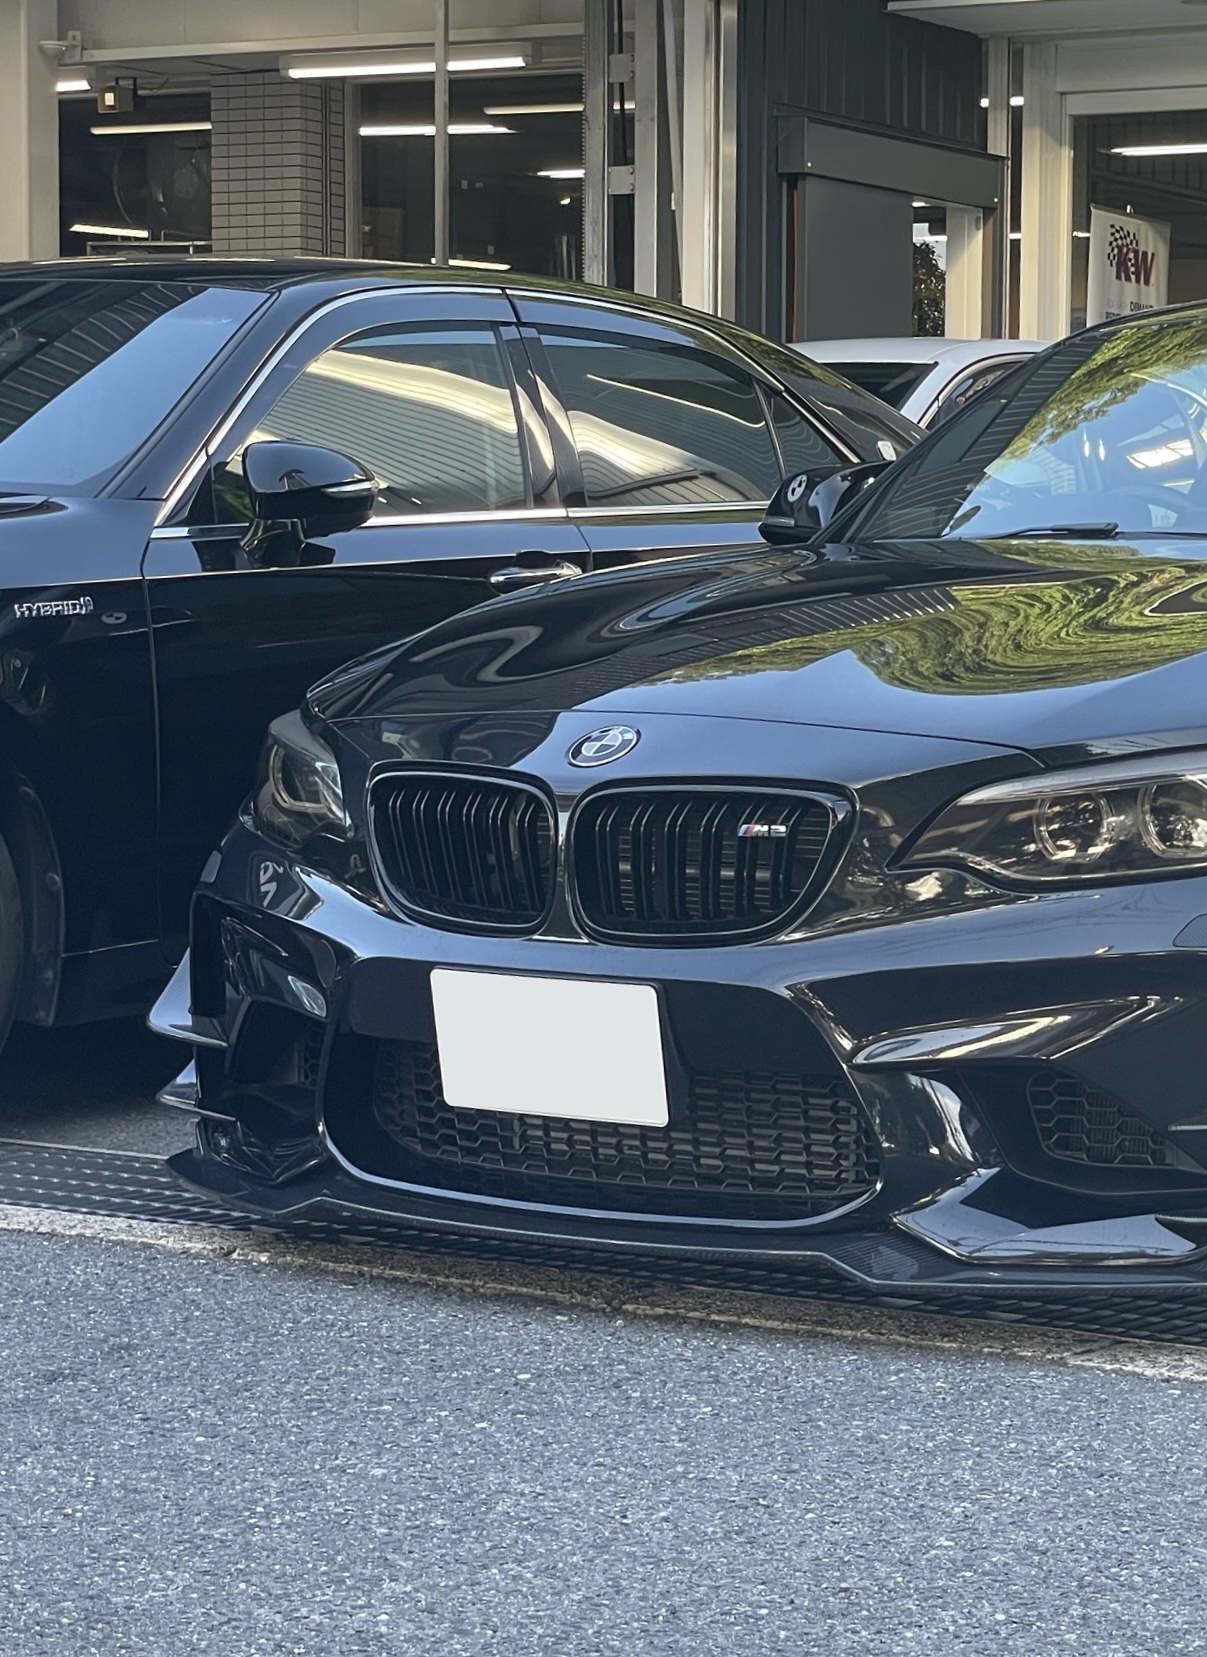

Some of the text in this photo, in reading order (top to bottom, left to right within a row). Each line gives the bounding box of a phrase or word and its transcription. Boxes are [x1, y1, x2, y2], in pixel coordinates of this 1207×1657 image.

[1115, 244, 1156, 287] KW
[14, 600, 81, 618] HYBRID
[752, 824, 787, 837] M2
